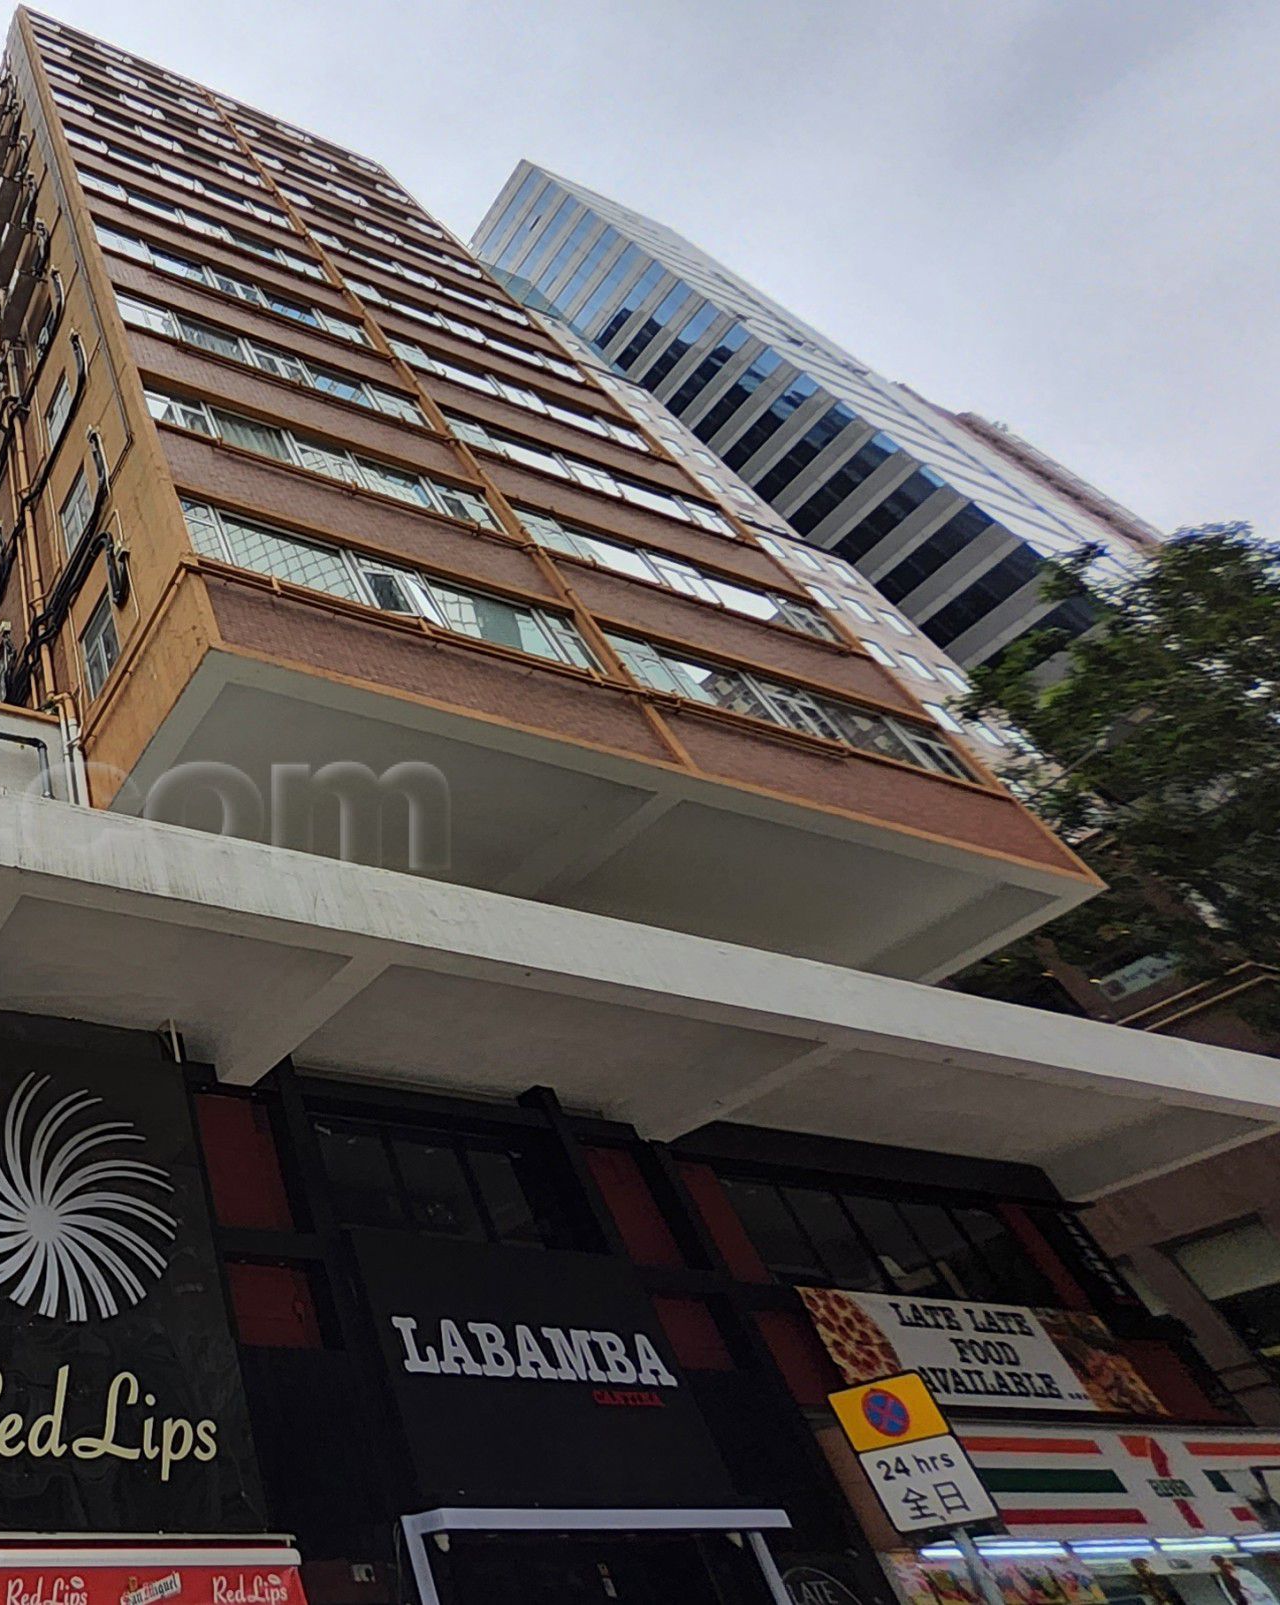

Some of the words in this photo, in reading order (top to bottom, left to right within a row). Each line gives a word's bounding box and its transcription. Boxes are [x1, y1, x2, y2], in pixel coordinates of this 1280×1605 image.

[889, 1302, 963, 1331] LATE
[964, 1308, 1035, 1336] LATE
[391, 1316, 678, 1387] LABAMBA
[949, 1337, 1020, 1366] FOOD
[71, 1371, 218, 1482] Lips
[876, 1456, 911, 1481] 24
[912, 1453, 955, 1474] hrs
[902, 1481, 971, 1521] 全日
[212, 1573, 247, 1604] Red
[246, 1573, 289, 1605] Lips
